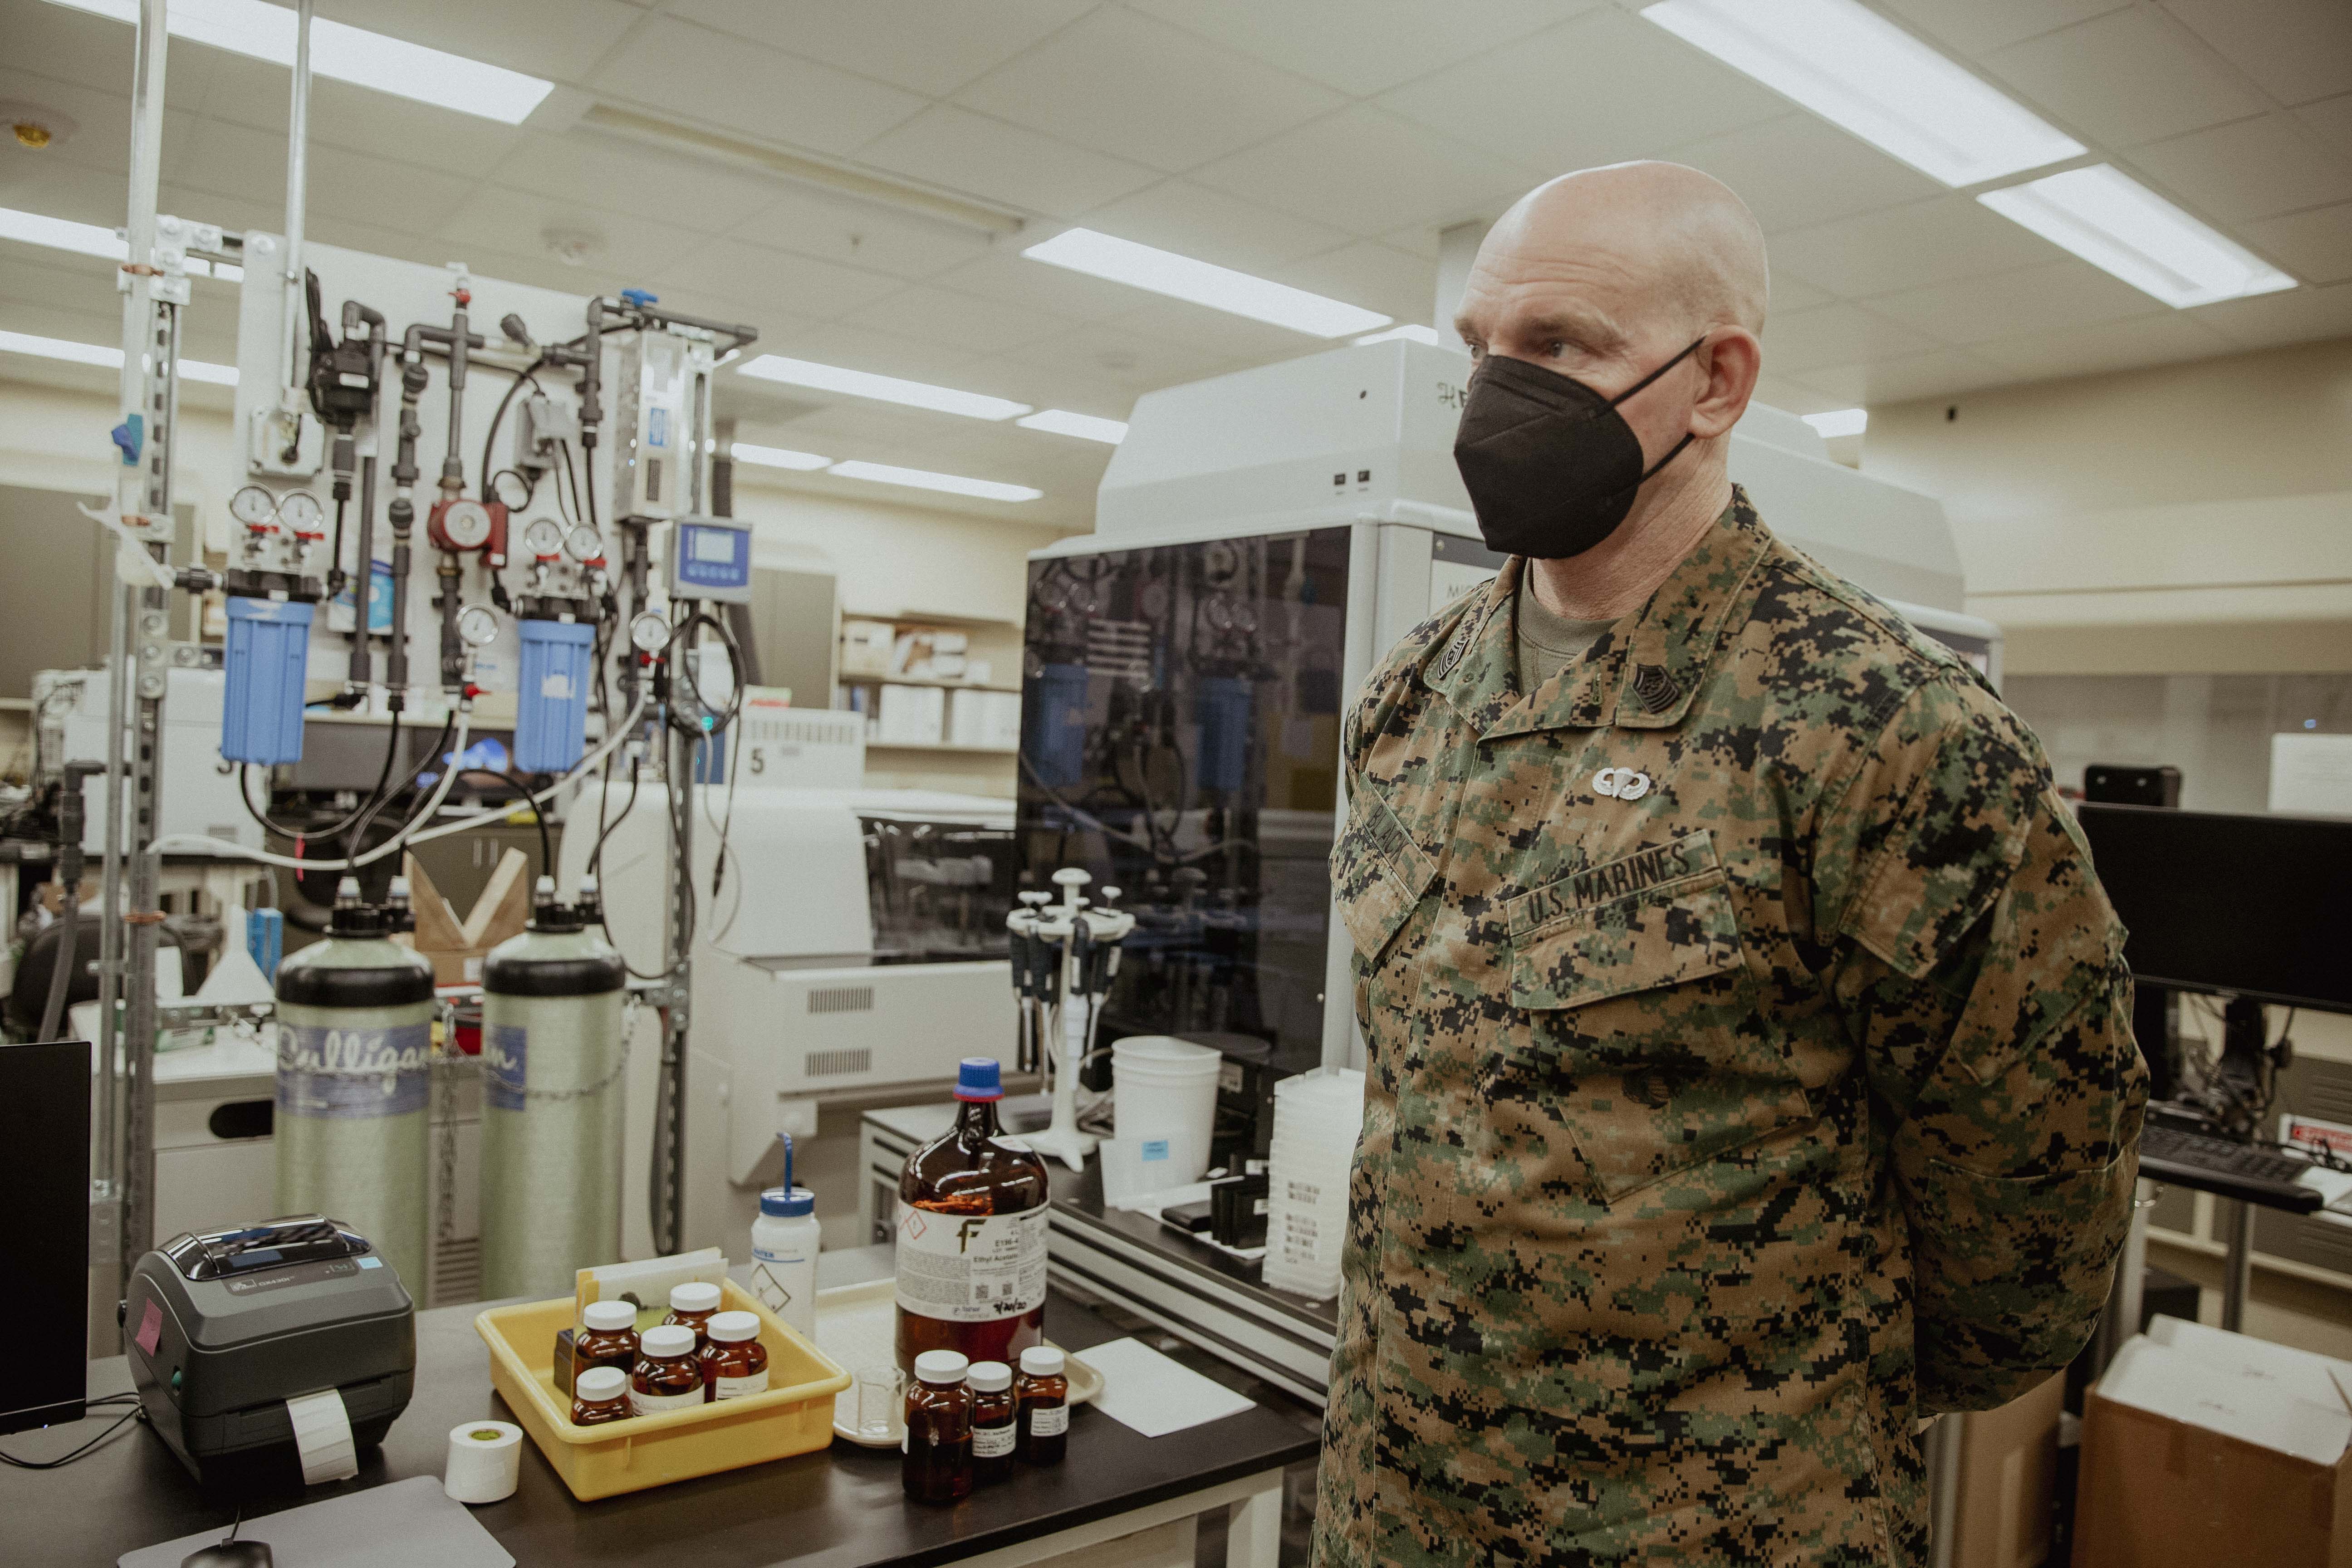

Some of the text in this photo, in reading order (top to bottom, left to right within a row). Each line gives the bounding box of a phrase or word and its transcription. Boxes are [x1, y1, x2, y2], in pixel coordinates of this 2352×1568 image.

[751, 748, 764, 774] 5
[1528, 843, 1690, 924] U.S. MARINES
